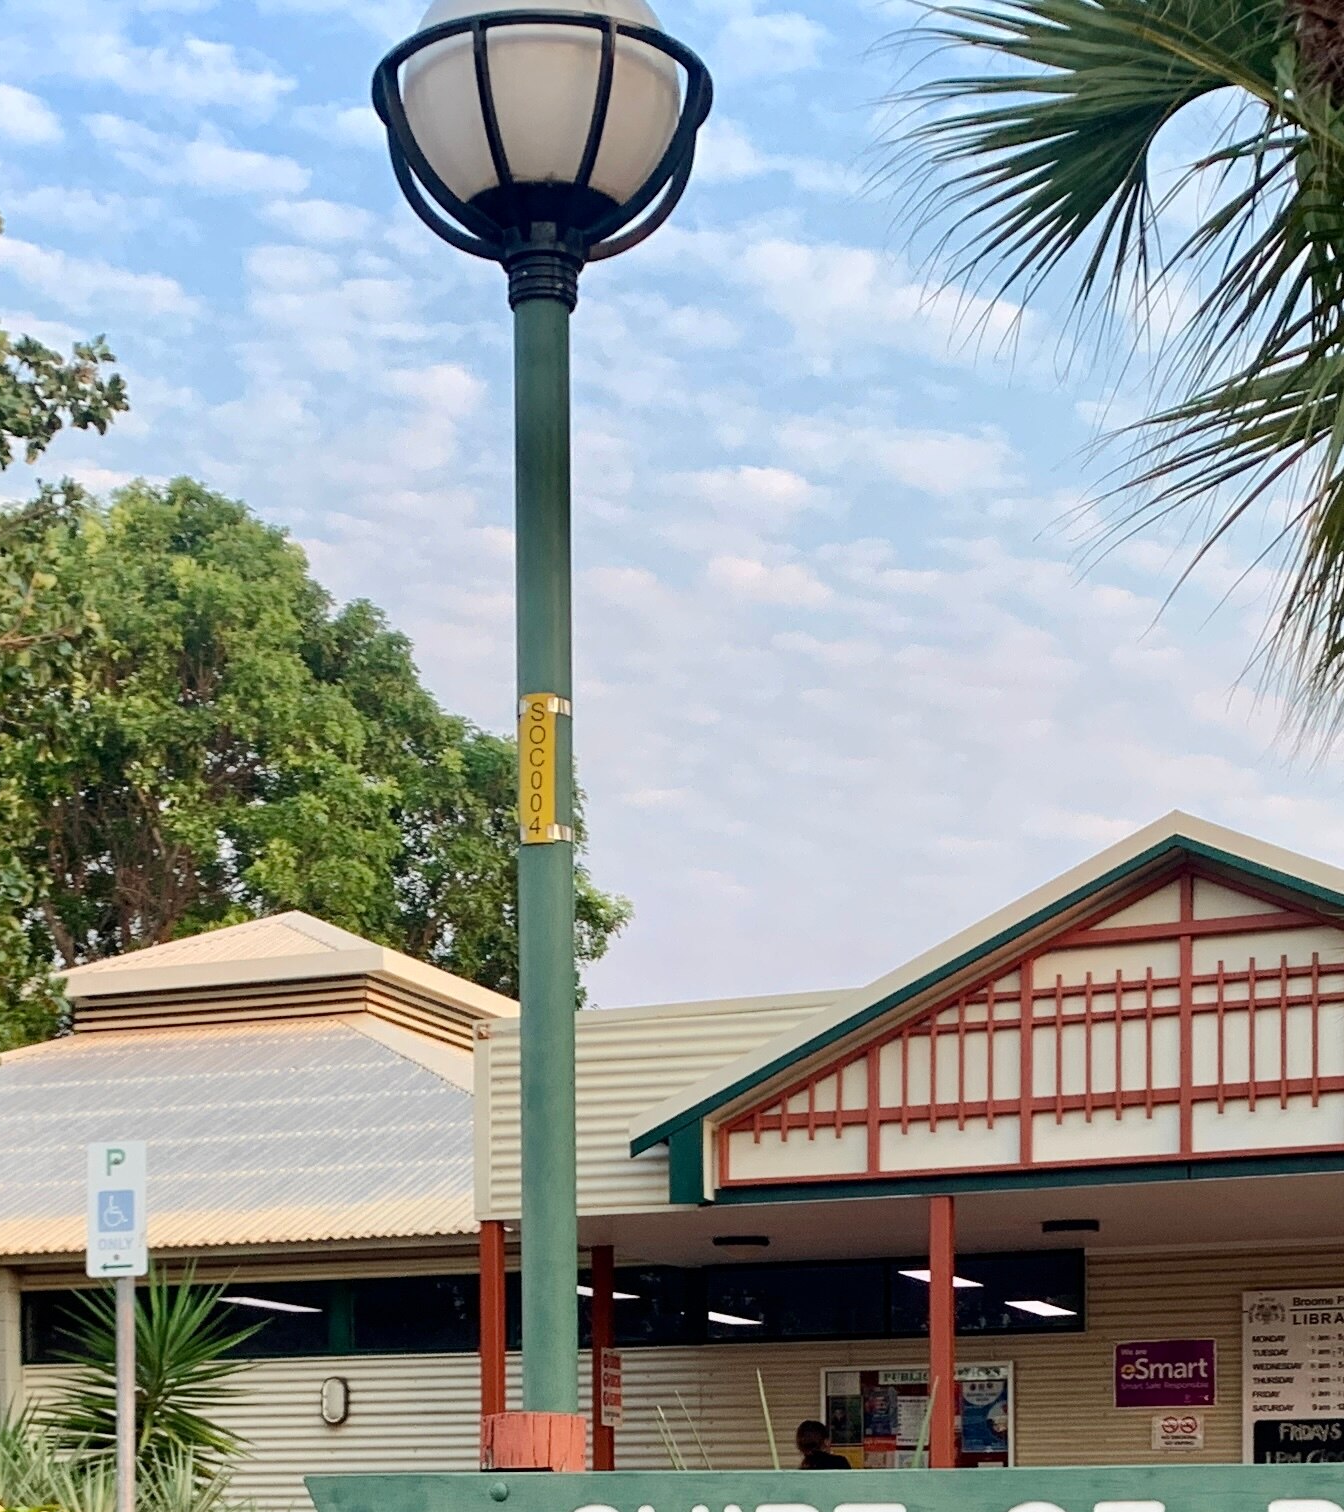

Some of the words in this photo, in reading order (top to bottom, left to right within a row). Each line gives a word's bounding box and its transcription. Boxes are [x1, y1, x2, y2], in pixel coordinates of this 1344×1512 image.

[529, 702, 546, 834] SOC004
[106, 1148, 125, 1176] P
[97, 1238, 134, 1250] ONLY
[1293, 1297, 1333, 1306] Broome
[1252, 1335, 1286, 1343] MONDAY
[1252, 1349, 1290, 1357] TUESDAY
[1120, 1357, 1209, 1380] eSmart
[1252, 1362, 1304, 1370] WEDNESDAY
[1252, 1376, 1294, 1384] THURSDAY
[1252, 1390, 1281, 1398] FRIDAY
[1252, 1404, 1295, 1412] SATURDAY
